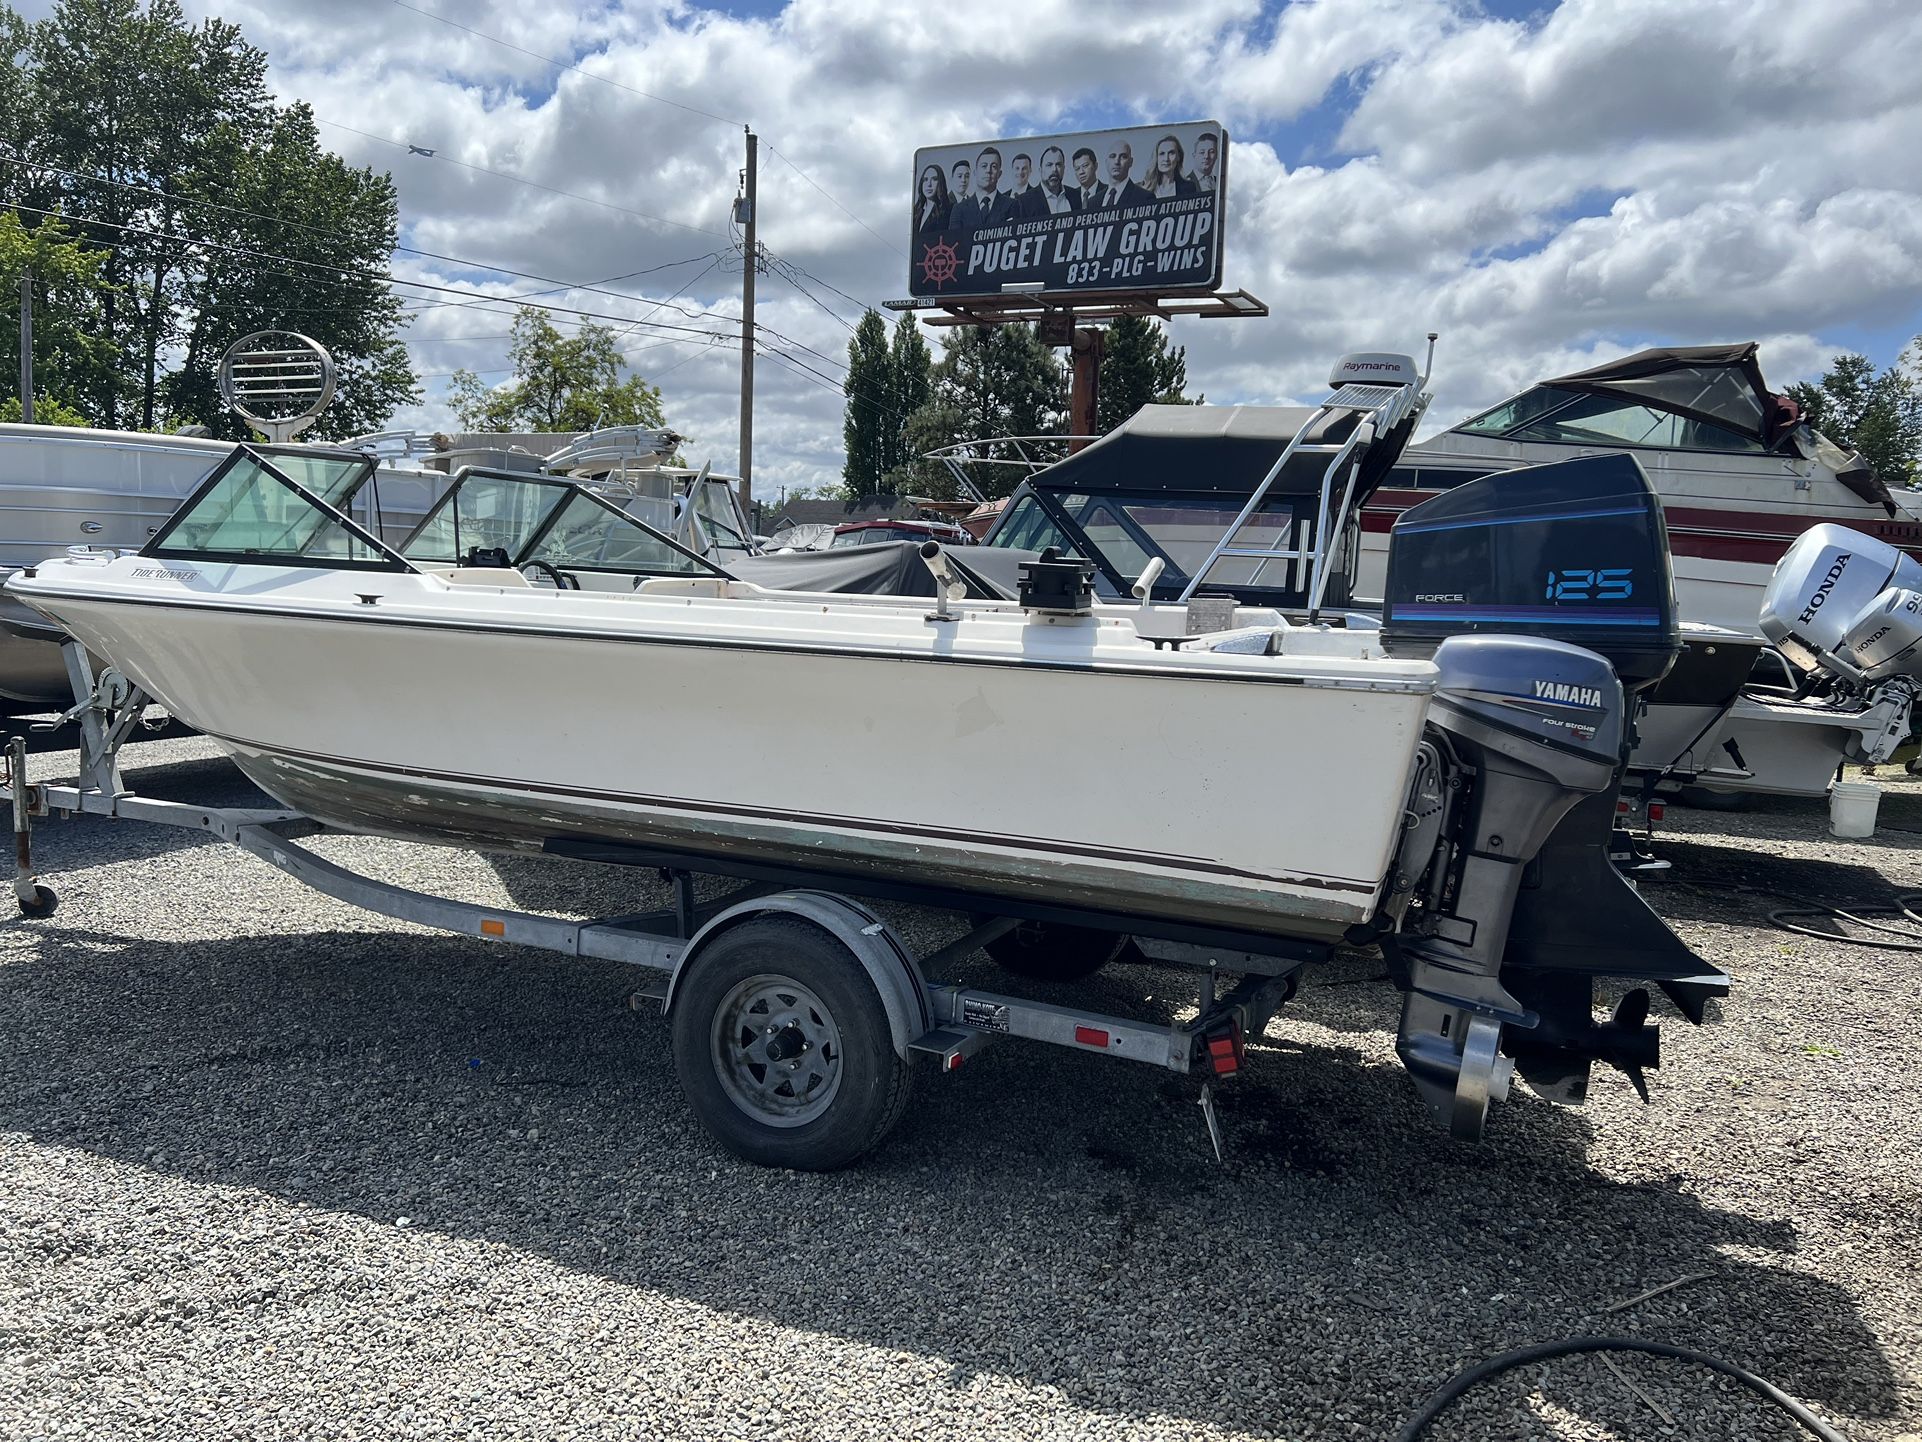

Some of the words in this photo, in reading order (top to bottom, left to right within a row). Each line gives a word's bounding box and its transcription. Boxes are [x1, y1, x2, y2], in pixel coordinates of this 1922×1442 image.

[973, 226, 1012, 241] CRIMINAL
[1016, 219, 1053, 236] DEFENSE
[1054, 217, 1073, 230] AND
[1075, 210, 1120, 227] PERSONAL
[1122, 204, 1158, 220] INJURY
[1159, 196, 1212, 215] ATTORNEYS
[967, 235, 1048, 275] PUGET
[1052, 225, 1114, 264] LAW
[1119, 211, 1212, 255] GROUP
[1066, 246, 1206, 285] 833-PLG-WINS
[1343, 362, 1401, 372] Raymarine
[1415, 594, 1465, 603] FORCE
[1546, 568, 1633, 600] 125
[1798, 553, 1851, 625] HONDA
[1777, 636, 1789, 647] 115
[1855, 625, 1892, 654] HONDA
[1535, 680, 1601, 707] YAMAHA
